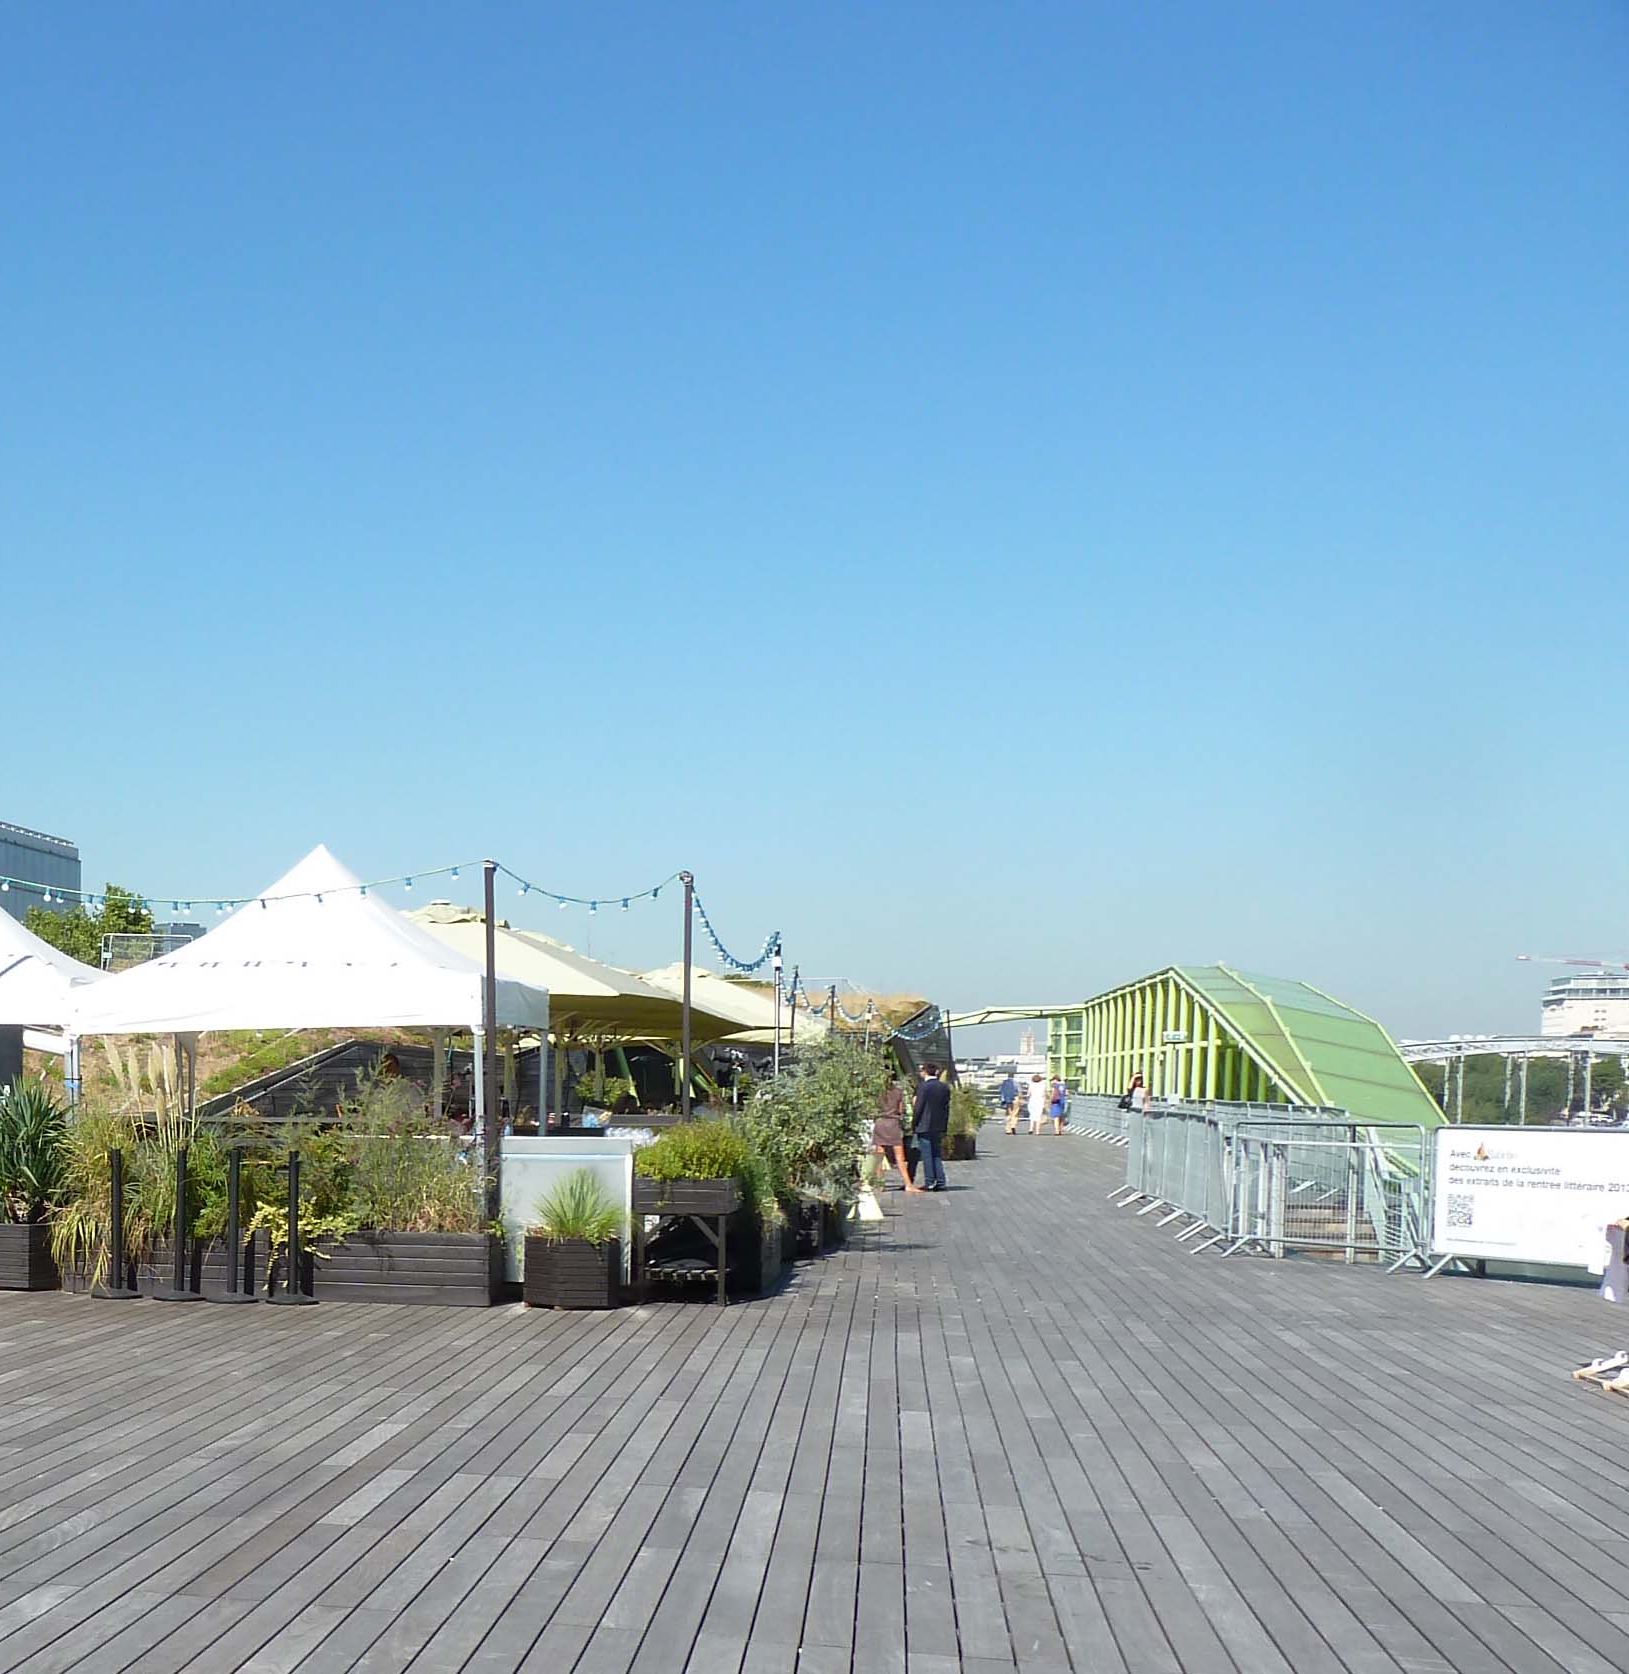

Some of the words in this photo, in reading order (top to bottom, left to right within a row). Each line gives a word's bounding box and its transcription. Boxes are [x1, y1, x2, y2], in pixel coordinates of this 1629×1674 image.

[1450, 1149, 1471, 1159] Avec
[1497, 1166, 1509, 1174] en
[1448, 1176, 1464, 1185] des
[1502, 1178, 1514, 1187] de
[1516, 1179, 1524, 1188] la
